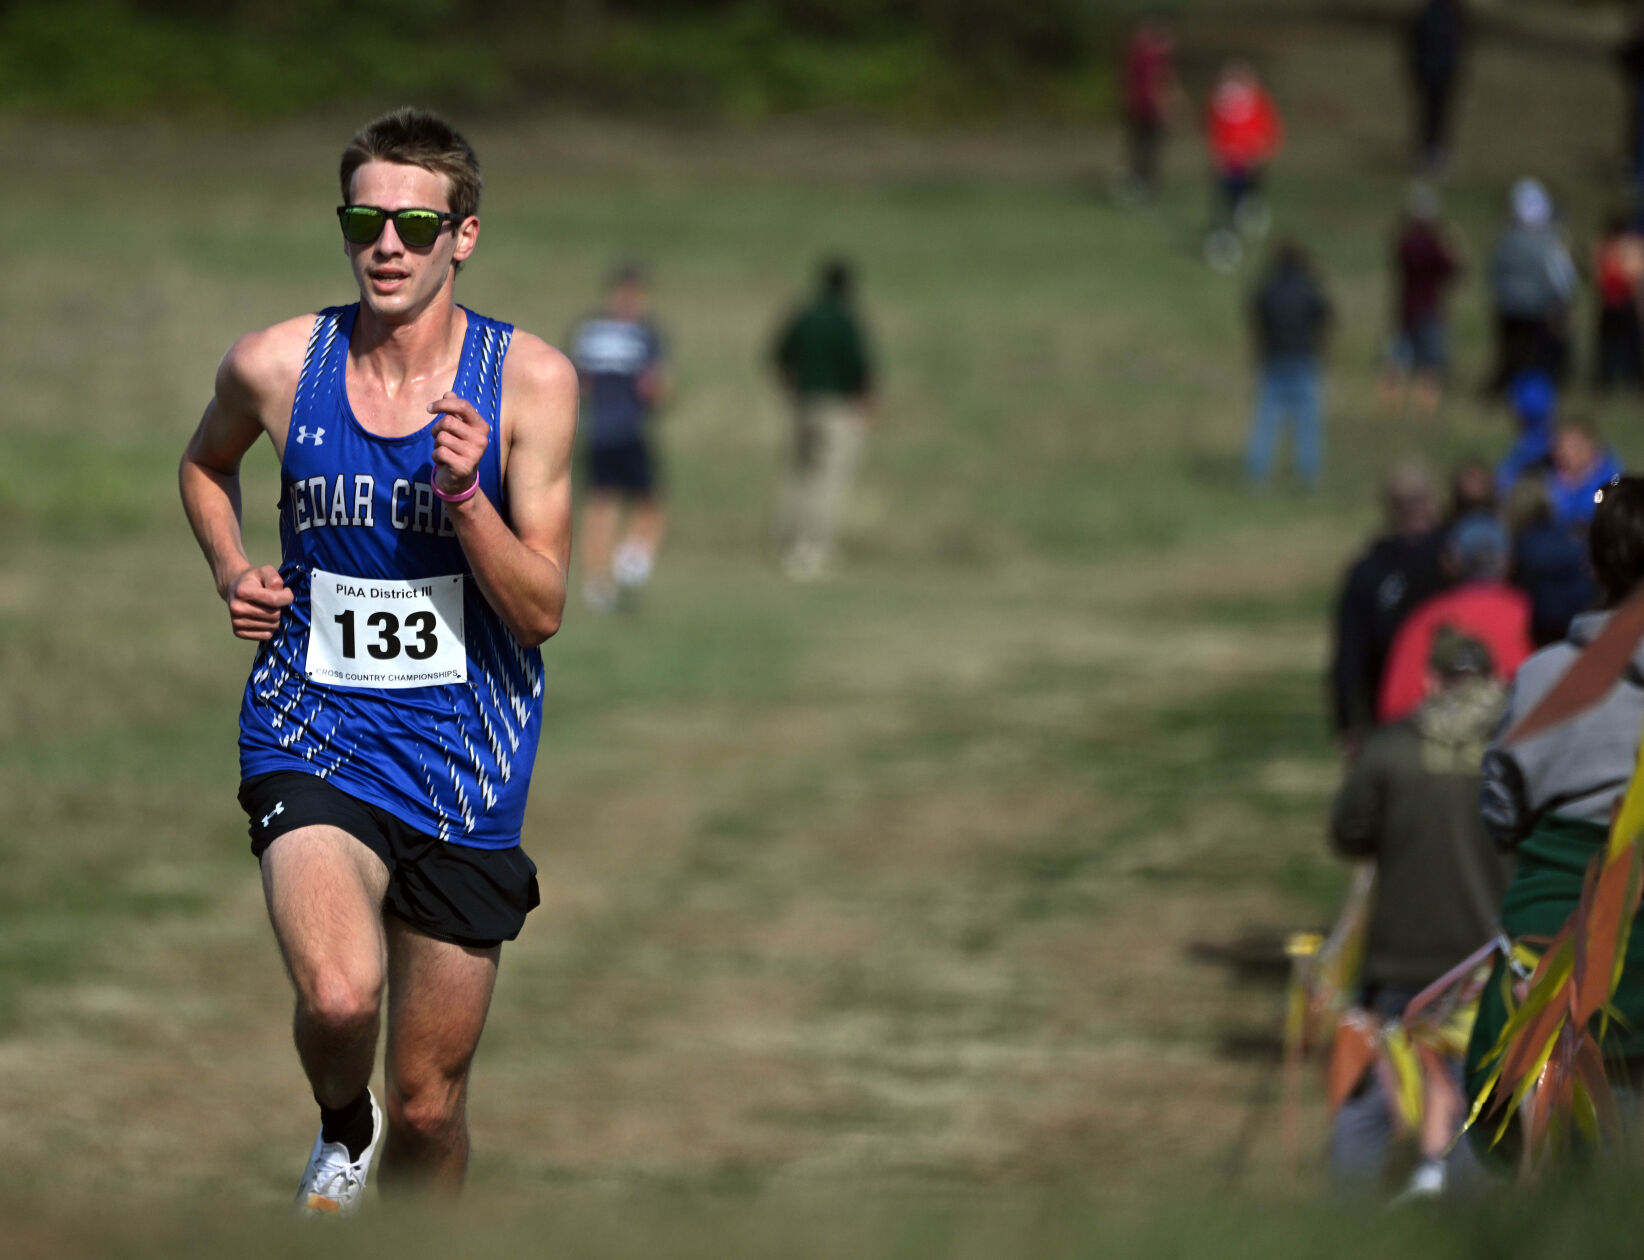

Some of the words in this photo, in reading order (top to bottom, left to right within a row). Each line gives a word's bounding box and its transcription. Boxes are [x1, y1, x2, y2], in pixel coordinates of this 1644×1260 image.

[336, 583, 366, 598] PIAA
[370, 587, 418, 599] District
[334, 609, 438, 660] 133
[316, 668, 344, 679] CROSS
[345, 673, 386, 682] COUNTRY
[388, 669, 458, 682] CHAMPIONSHIPS
